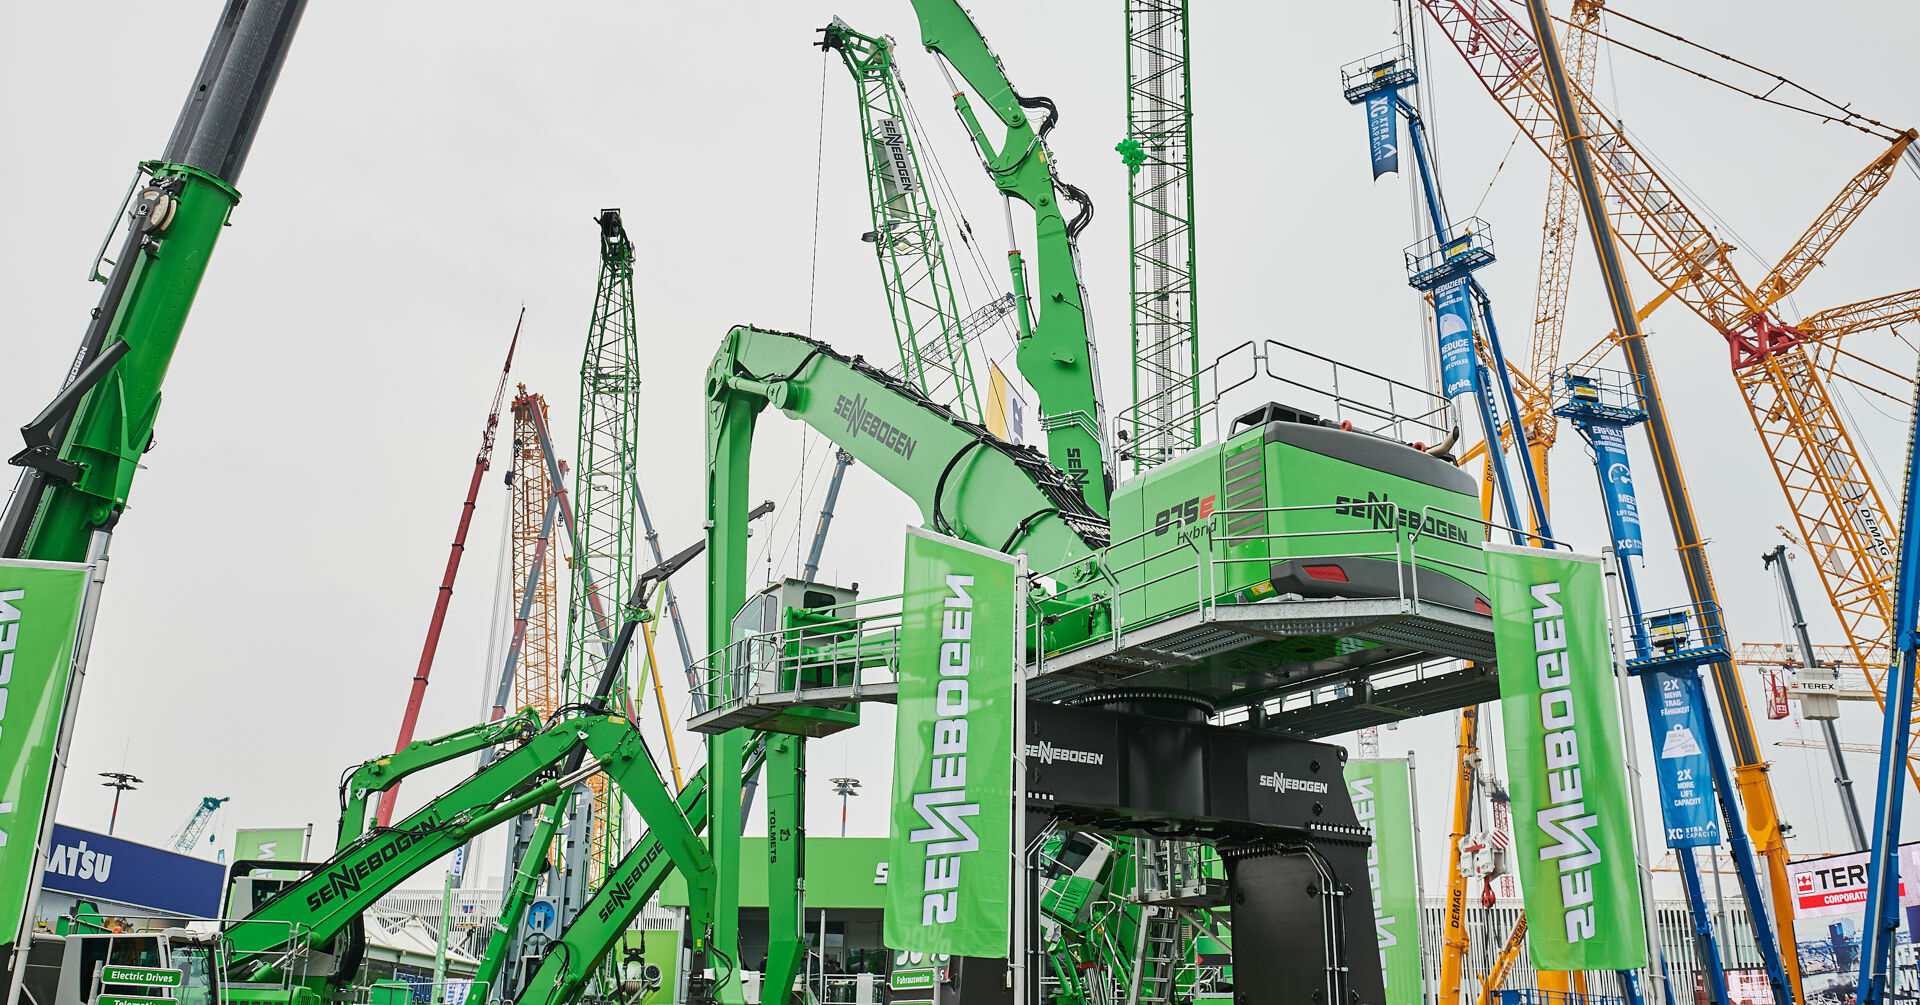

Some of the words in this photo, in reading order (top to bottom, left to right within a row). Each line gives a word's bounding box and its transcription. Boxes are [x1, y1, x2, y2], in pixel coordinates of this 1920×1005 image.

[1370, 96, 1389, 118] XC
[1371, 119, 1383, 162] CAPACITY
[883, 120, 914, 192] SENNEBOGEN
[1441, 338, 1470, 354] REDUCE
[833, 393, 918, 462] SENNEBOGEN
[1335, 491, 1468, 544] SENNEBOGEN
[1177, 517, 1217, 546] Hybrid
[1860, 509, 1891, 556] DEMAG
[1663, 678, 1680, 691] 2X
[1801, 682, 1835, 690] TEREX
[1025, 740, 1104, 766] SENNEBOGEN
[1259, 771, 1328, 794] SENNEBOGEN
[1676, 768, 1693, 781] 2X
[769, 808, 777, 864] TOLMETS
[1668, 827, 1684, 840] XC
[306, 815, 437, 913] SENNEBOGEN
[598, 839, 665, 924] SENNEBOGE
[1450, 888, 1462, 929] DEMAG
[1823, 890, 1868, 905] CORPORATI
[111, 970, 144, 981] Electric
[145, 972, 173, 983] Drives
[896, 973, 930, 985] Fahrausweise
